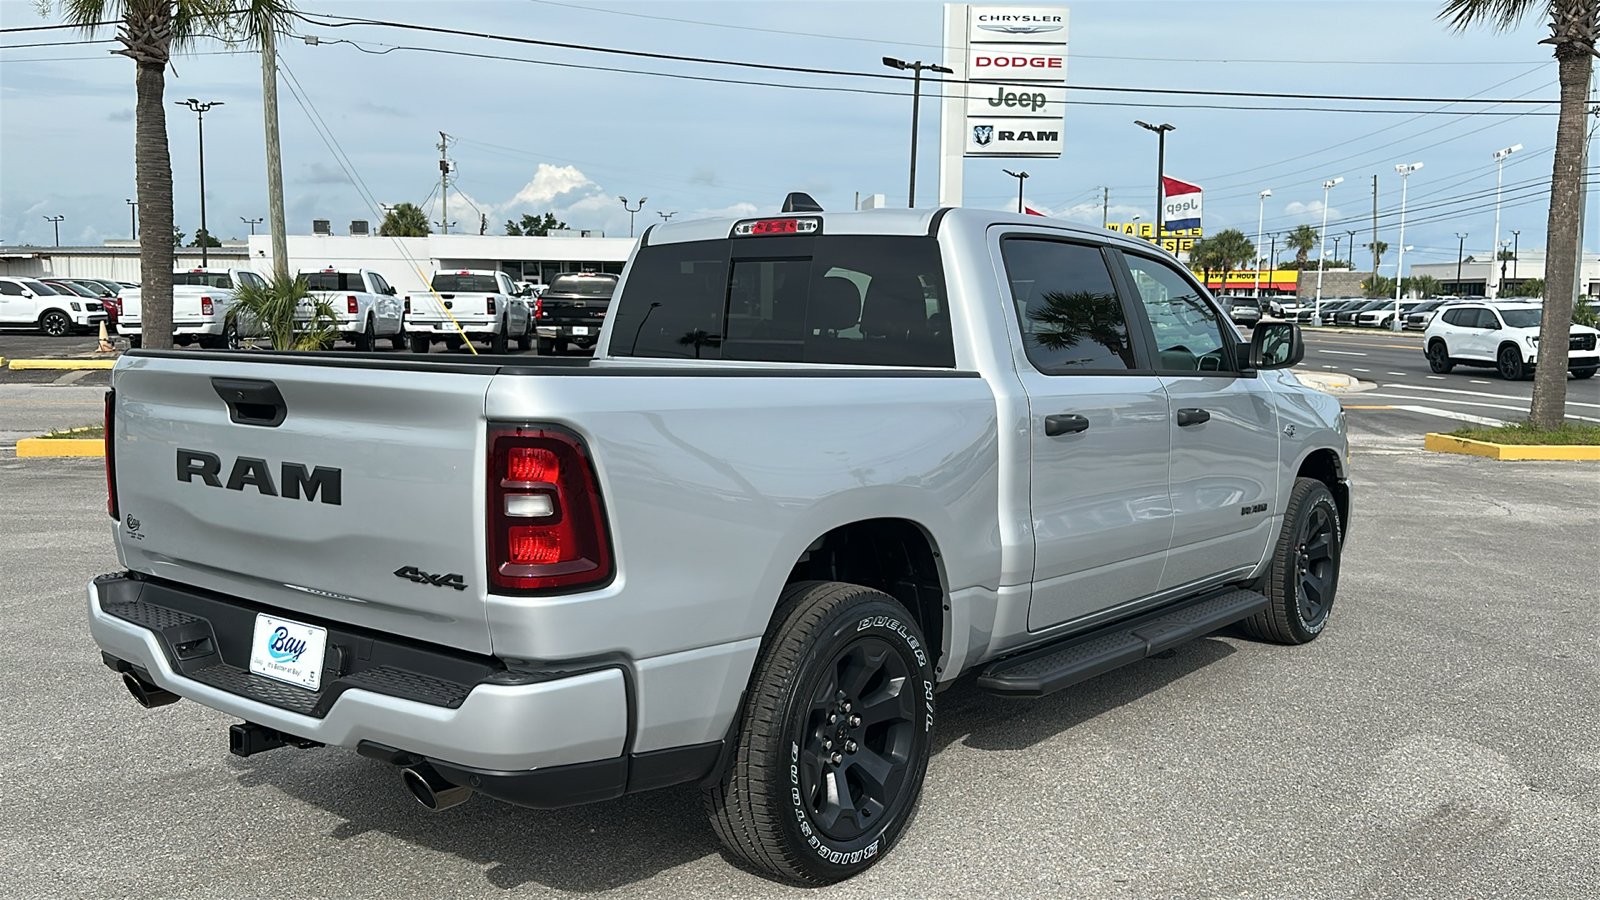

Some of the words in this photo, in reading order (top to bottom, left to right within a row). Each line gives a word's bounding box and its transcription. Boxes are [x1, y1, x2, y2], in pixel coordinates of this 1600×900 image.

[975, 56, 1063, 69] DODGE
[988, 87, 1047, 112] Jeep
[998, 130, 1059, 141] RAM
[176, 447, 342, 506] RAM
[270, 626, 307, 663] Bay
[857, 615, 927, 667] DUELER
[924, 680, 934, 732] H/L
[790, 741, 880, 865] BRIDGESTONE
